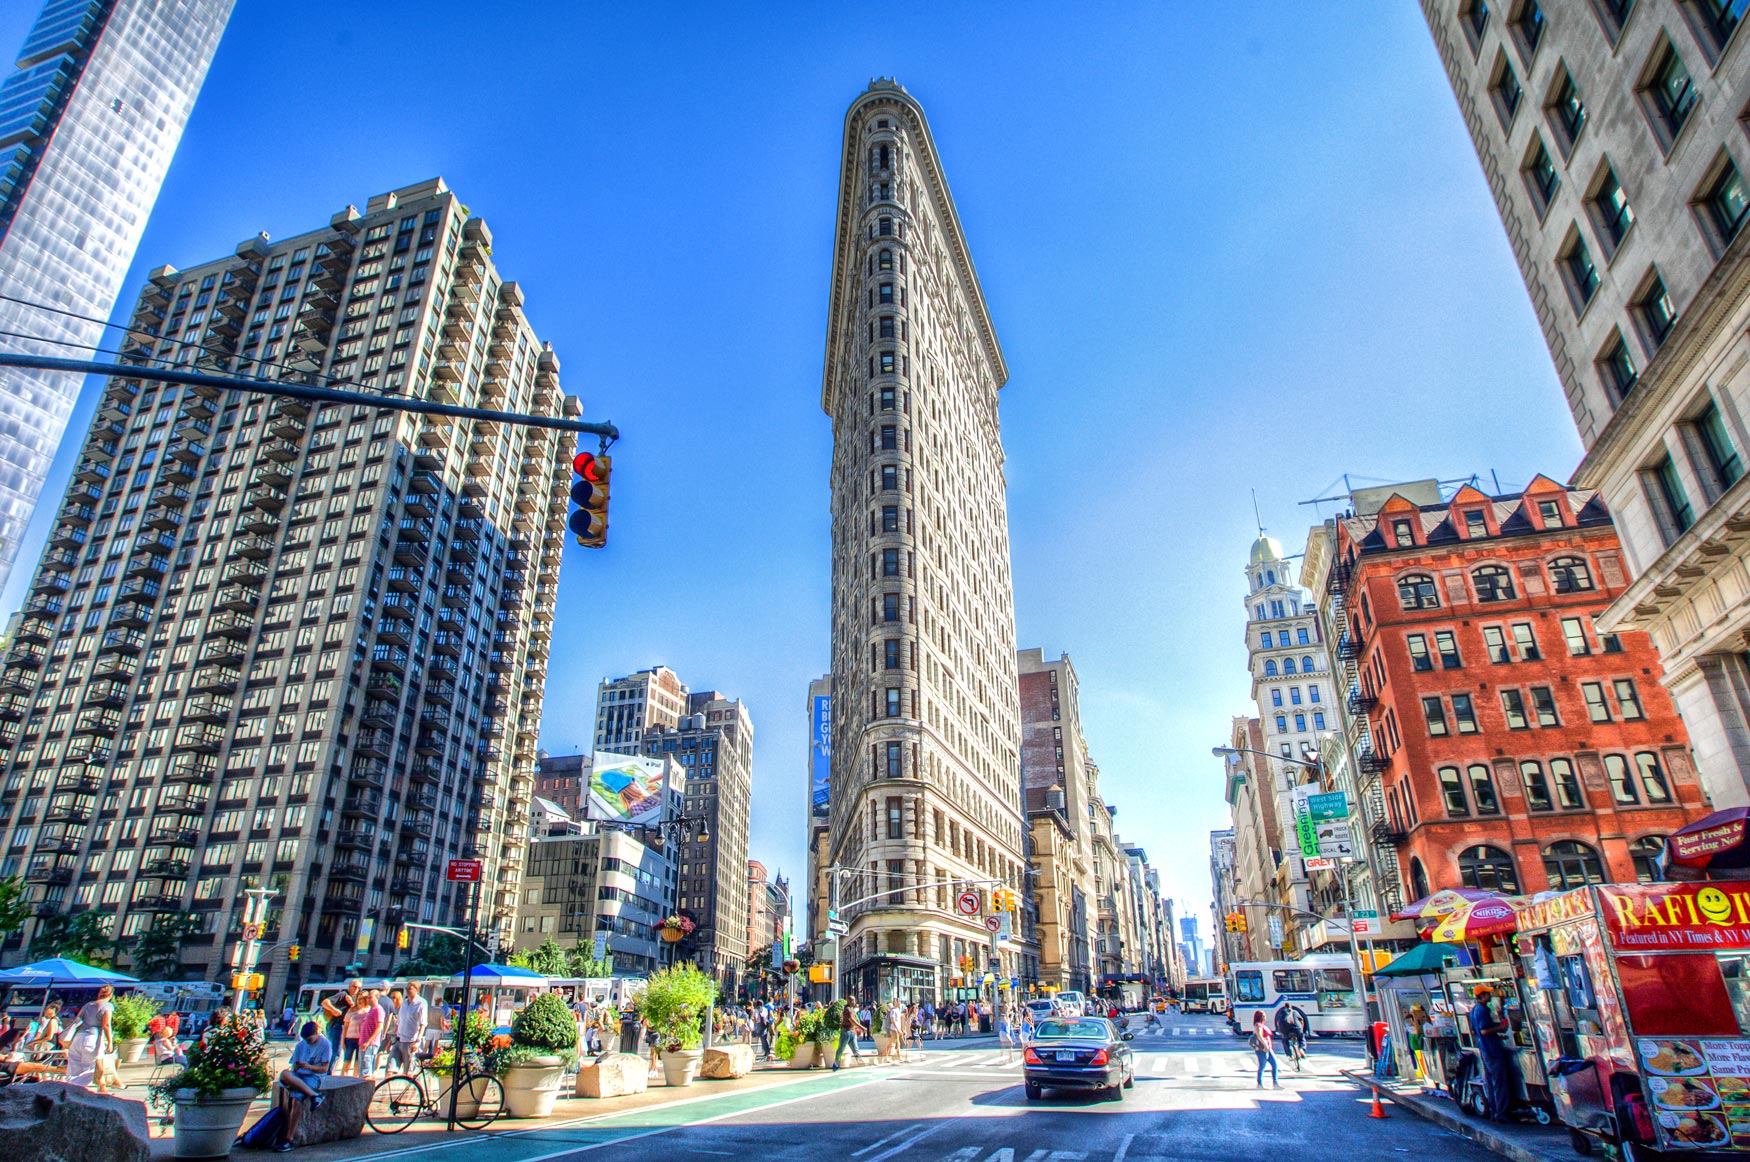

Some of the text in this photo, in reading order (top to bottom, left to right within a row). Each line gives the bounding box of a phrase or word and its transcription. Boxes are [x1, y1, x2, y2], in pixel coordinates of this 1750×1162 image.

[1298, 798, 1314, 856] Greening
[1677, 823, 1743, 845] Fast Fresh &
[1680, 842, 1719, 855] Serving
[1306, 858, 1331, 868] GREY
[1620, 931, 1656, 944] Featured
[1658, 931, 1669, 943] in
[1669, 931, 1683, 943] NY
[1684, 930, 1713, 943] Times
[1714, 930, 1724, 943] &
[1724, 930, 1740, 943] NY
[1708, 1053, 1730, 1061] More
[1712, 1065, 1735, 1073] Same
